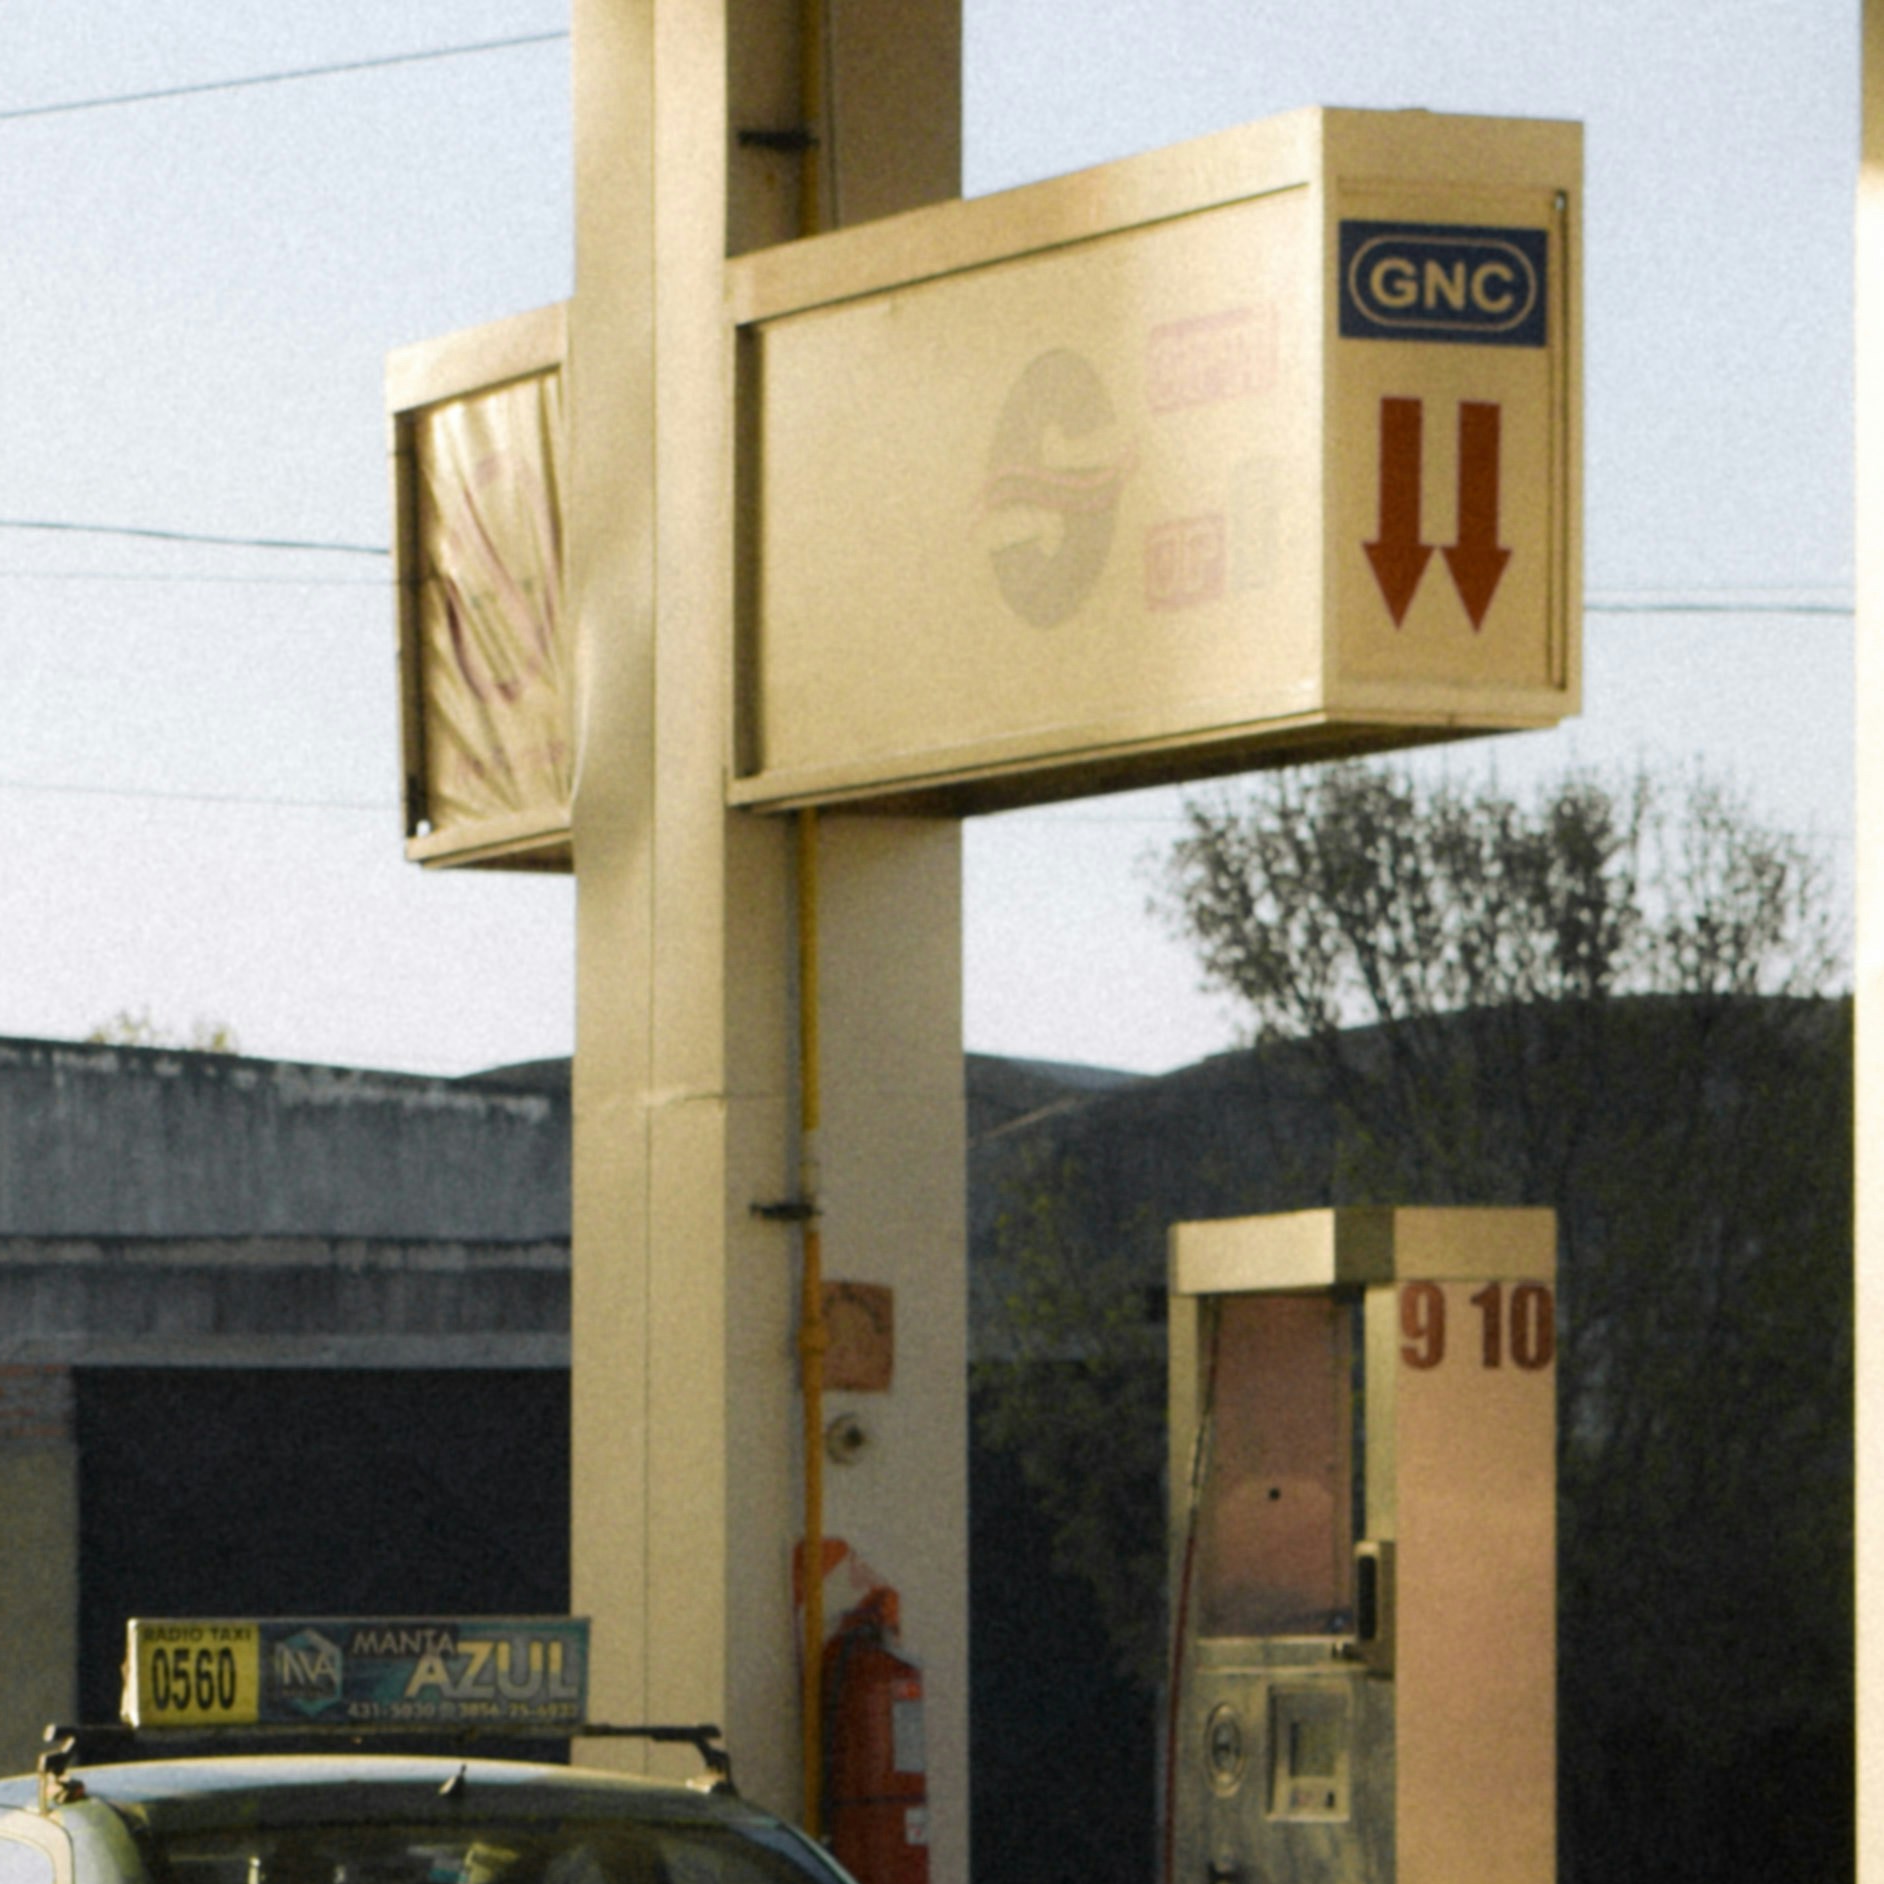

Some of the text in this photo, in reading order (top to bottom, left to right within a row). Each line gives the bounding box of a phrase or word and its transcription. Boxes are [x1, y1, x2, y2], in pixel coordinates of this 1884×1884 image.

[1370, 256, 1514, 313] GNC
[1399, 1281, 1556, 1369] 9 10
[144, 1627, 252, 1641] RADIO TAXI
[353, 1630, 455, 1654] MANTA
[152, 1647, 236, 1711] 0560
[405, 1641, 578, 1697] AZUL
